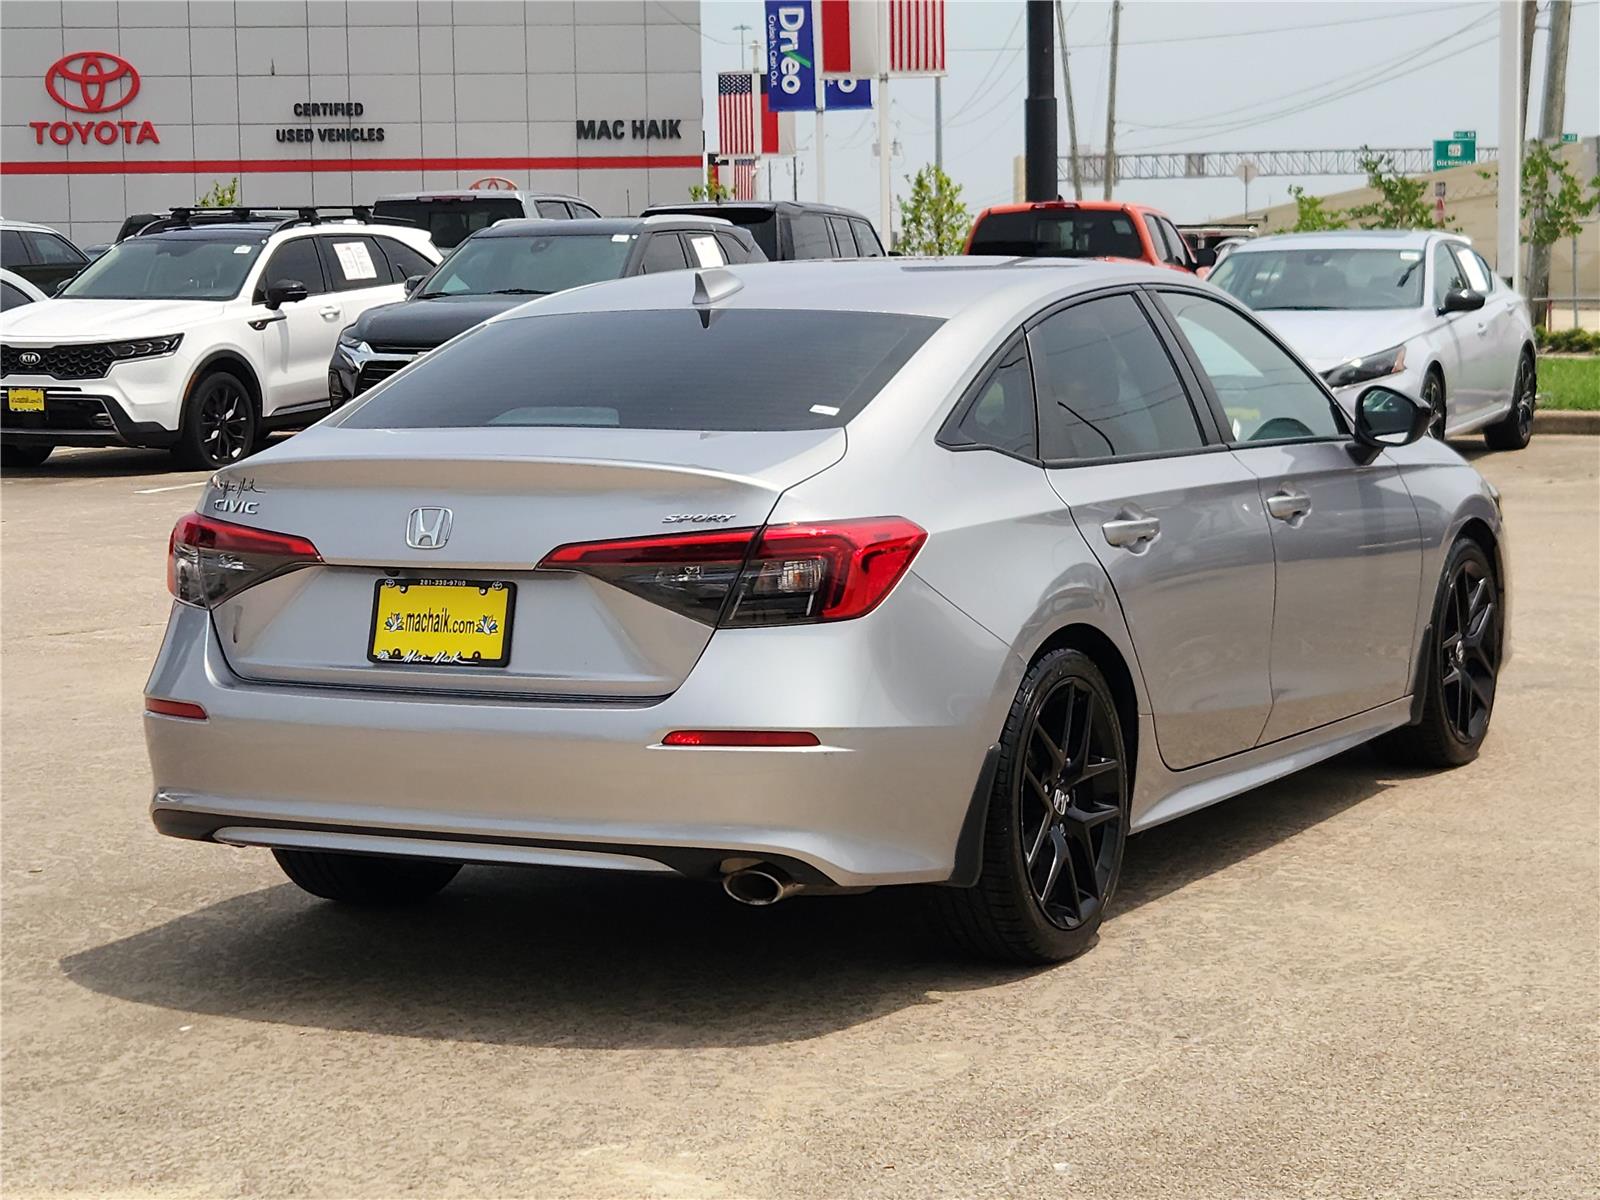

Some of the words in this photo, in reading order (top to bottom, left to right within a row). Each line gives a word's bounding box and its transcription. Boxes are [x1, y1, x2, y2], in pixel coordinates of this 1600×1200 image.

[769, 50, 778, 71] Cash
[293, 102, 364, 117] CERTIFIED
[29, 120, 160, 145] TOYOTA
[275, 128, 315, 143] USED
[317, 127, 385, 142] VEHICLES
[576, 119, 625, 140] MAC
[631, 119, 682, 140] HAIK
[22, 354, 37, 362] KIA
[213, 499, 260, 514] CIVIC
[662, 513, 737, 524] SPORT
[405, 608, 475, 634] machaik.com
[401, 650, 431, 663] Mac
[430, 651, 479, 664] Haik
